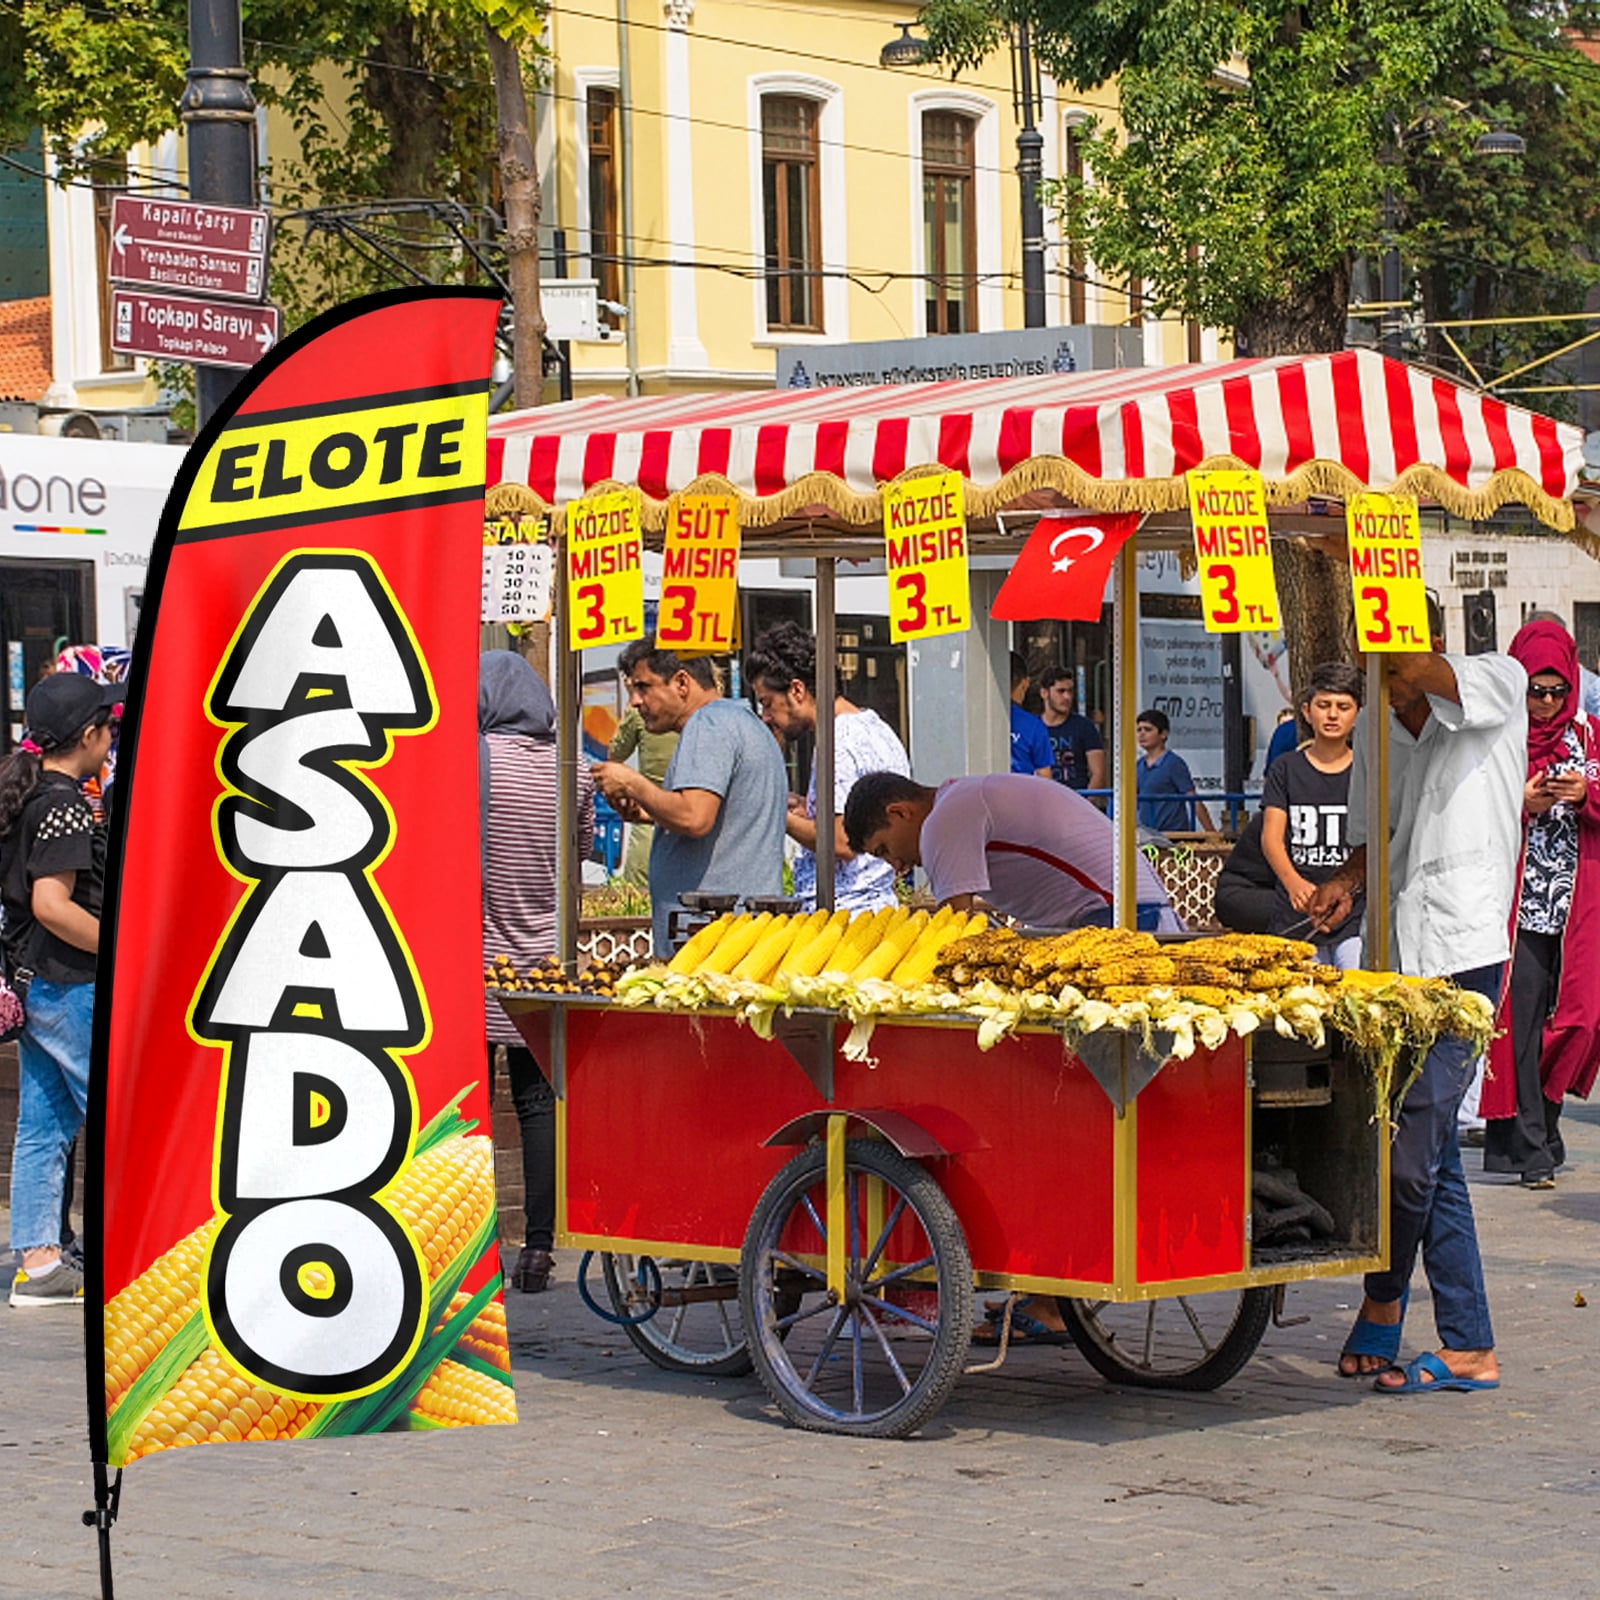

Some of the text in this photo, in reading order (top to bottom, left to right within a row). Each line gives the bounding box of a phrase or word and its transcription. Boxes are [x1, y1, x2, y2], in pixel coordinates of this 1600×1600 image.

[142, 203, 236, 234] Kapalı Çarşı
[139, 247, 199, 269] Yerebatan
[150, 266, 223, 287] Basilica Cistern
[138, 301, 253, 340] Topkapı Sarayı
[195, 340, 229, 356] Palace
[210, 418, 465, 503] ELOTE
[0, 464, 107, 516] one
[1196, 485, 1259, 516] KÖZDE
[573, 508, 634, 542] KÖZDE
[676, 504, 730, 539] SÜT
[891, 493, 957, 530] KÖZDE
[1353, 511, 1414, 540] KÖZDE
[888, 527, 964, 569] MISIR
[1196, 526, 1269, 557] MISIR
[504, 564, 524, 575] 20
[571, 541, 640, 581] MISIR
[664, 548, 737, 579] MISIR
[1352, 547, 1422, 579] MISIR
[577, 584, 638, 641] 3 TL
[896, 572, 962, 633] 3 TL
[1207, 564, 1273, 624] 3 TL
[659, 585, 729, 642] 3 TL
[1362, 586, 1424, 644] 3 TL
[1289, 805, 1347, 846] BT
[194, 554, 434, 1395] ASADO
